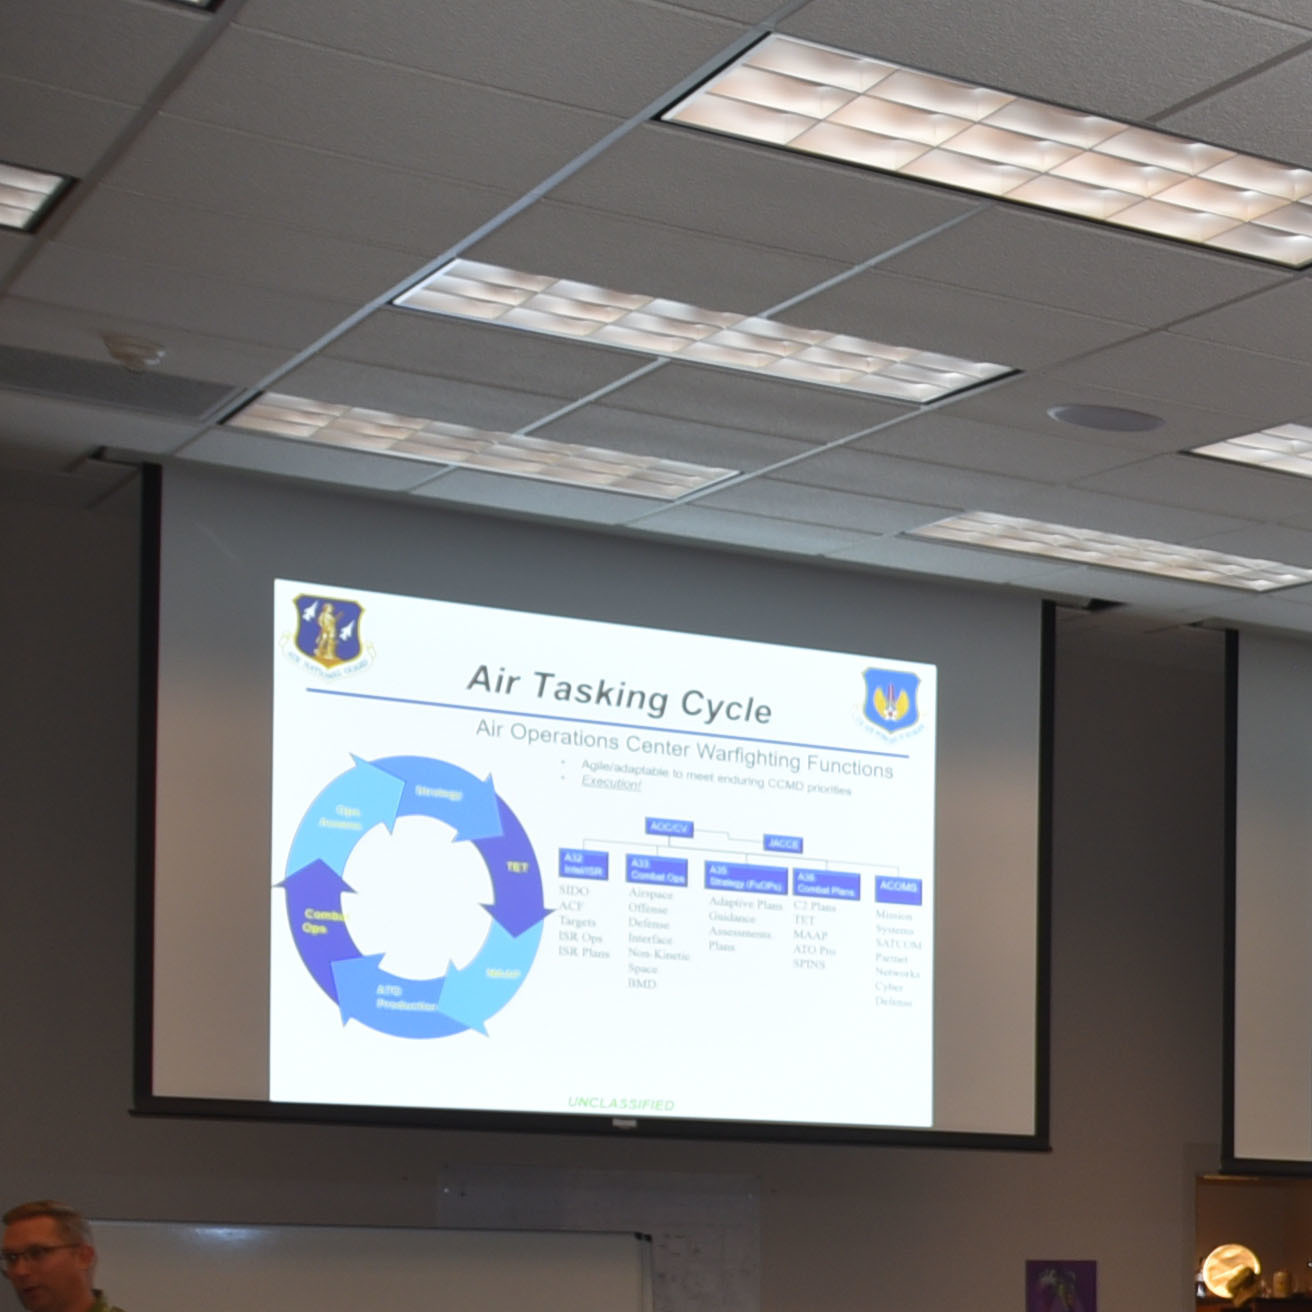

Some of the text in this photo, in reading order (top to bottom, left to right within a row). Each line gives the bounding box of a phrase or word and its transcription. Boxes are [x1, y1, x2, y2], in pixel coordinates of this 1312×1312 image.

[466, 662, 772, 731] Air Tasking Cycle
[476, 718, 894, 779] Air Operations Center Warfighting Functions
[581, 759, 669, 779] Agile/adaptable
[672, 769, 683, 779] to
[686, 770, 713, 782] meet
[717, 773, 764, 789] enduring
[807, 782, 851, 798] priorities
[581, 773, 642, 791] Execution!
[629, 887, 673, 901] Airspace
[628, 902, 667, 914] Offense
[709, 895, 783, 911] Adaptive Plans
[811, 902, 836, 912] Plans
[305, 909, 349, 921] Comba
[709, 911, 755, 923] Guidance
[560, 915, 596, 929] Targets
[628, 917, 669, 929] Defense
[559, 930, 602, 944] ISR Ops
[628, 932, 672, 945] Interface
[793, 929, 827, 941] MAAP
[559, 946, 609, 958] ISR Plans
[708, 940, 735, 952] Plans
[627, 963, 657, 976] Space
[873, 981, 902, 993] Cyber
[568, 1096, 675, 1111] UNCLASSIFIED
